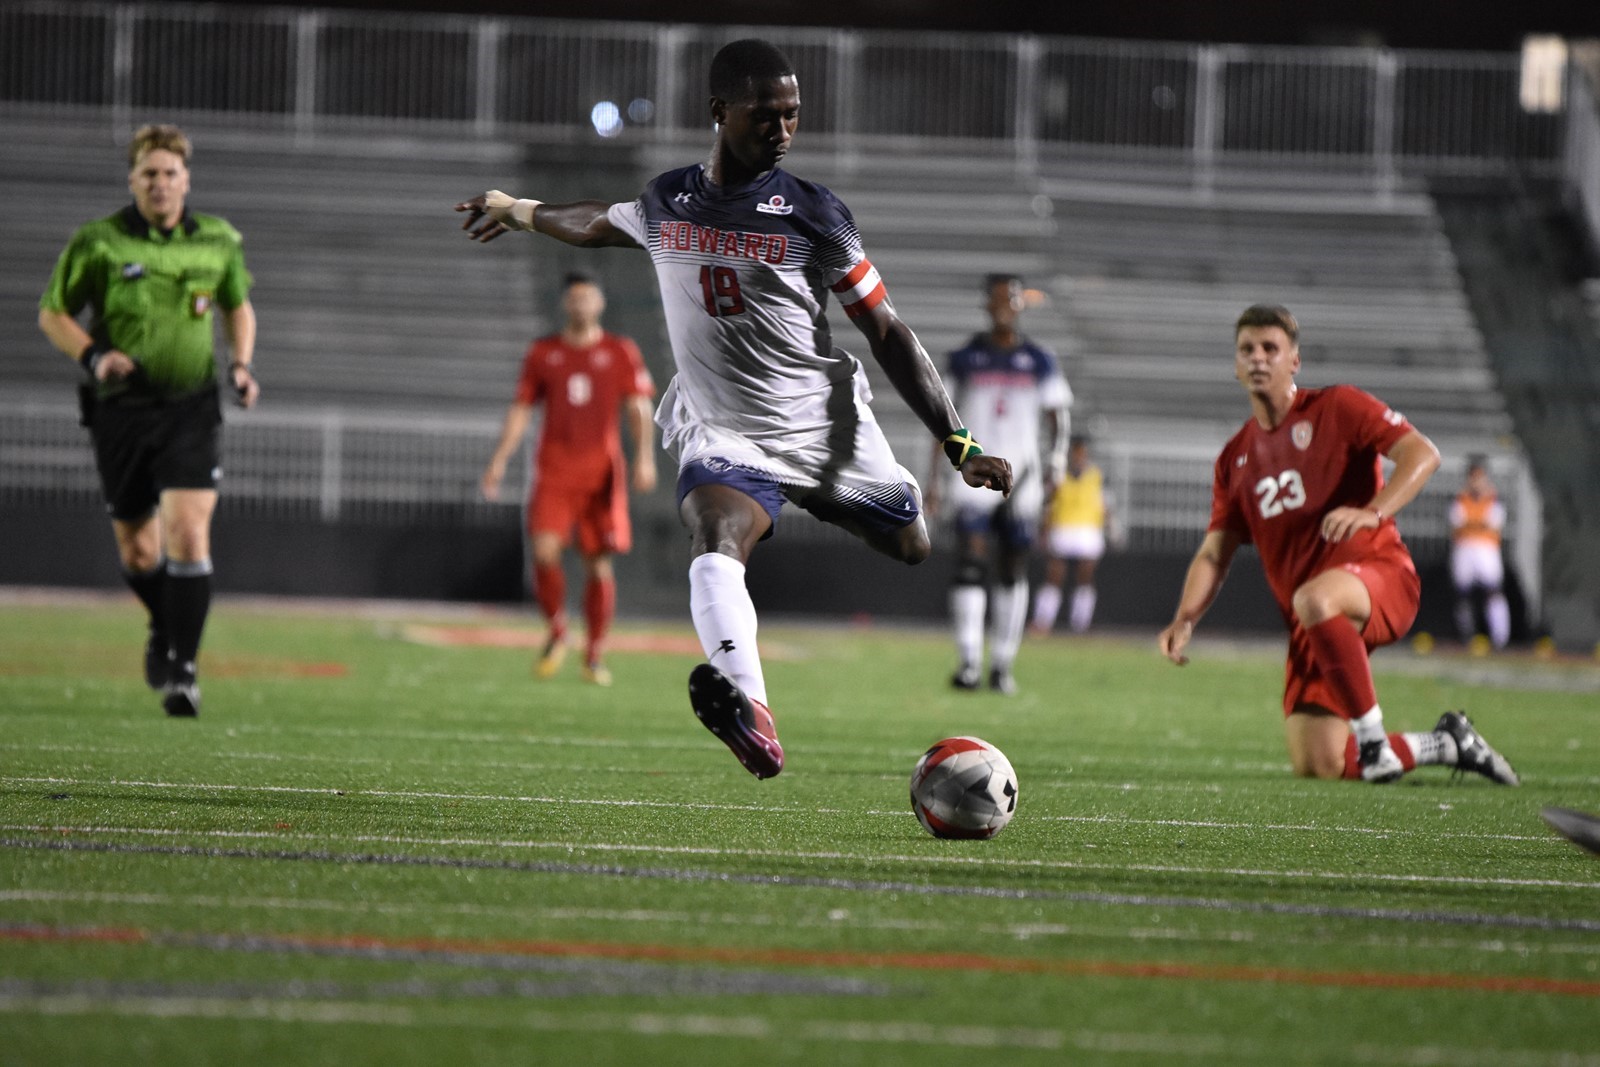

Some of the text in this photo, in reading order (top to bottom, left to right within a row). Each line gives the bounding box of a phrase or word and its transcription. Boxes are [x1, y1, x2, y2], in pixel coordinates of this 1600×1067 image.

[659, 221, 789, 265] HOWARD
[699, 264, 746, 317] 19
[1255, 469, 1307, 520] 23
